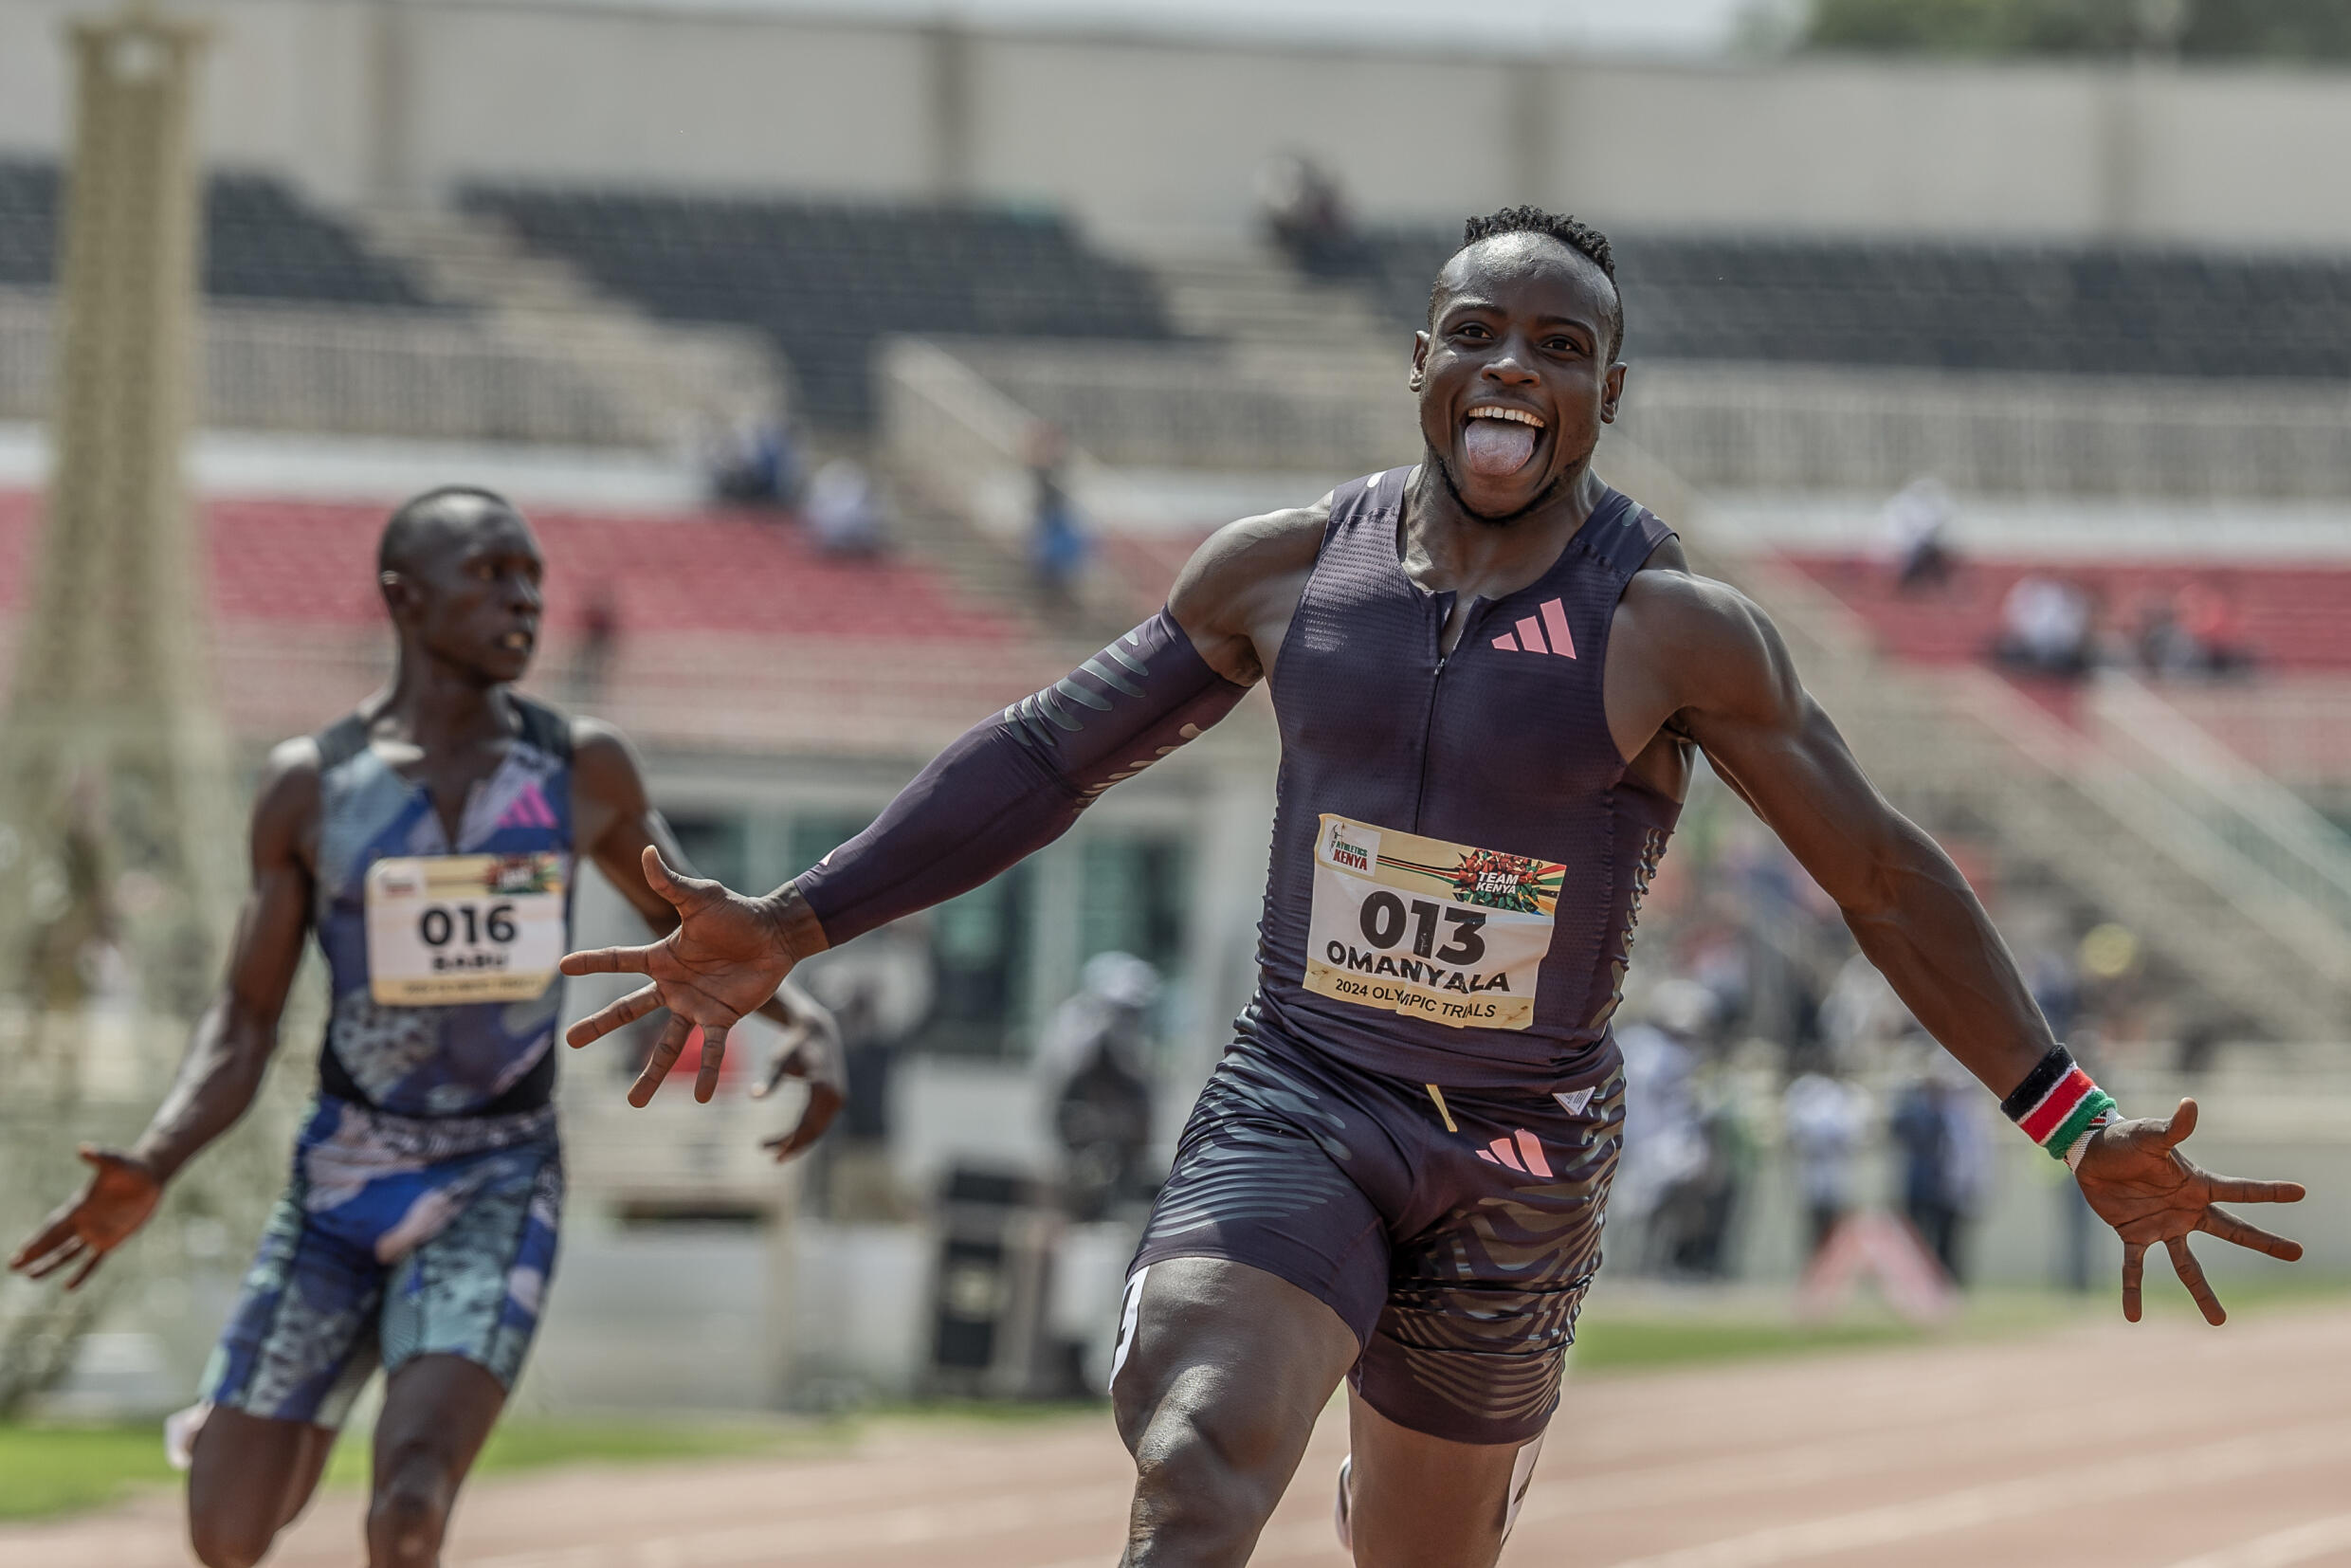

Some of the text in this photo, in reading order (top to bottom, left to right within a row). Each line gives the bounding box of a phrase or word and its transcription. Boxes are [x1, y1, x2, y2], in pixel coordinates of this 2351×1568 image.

[1333, 848, 1367, 871] KENYA
[1336, 841, 1367, 857] ATHLETICS
[1476, 882, 1516, 894] KENYA
[1479, 871, 1519, 884] TEAM
[420, 903, 517, 946] 016
[1359, 890, 1486, 966] 013
[1326, 939, 1511, 994] OMANYALA
[1336, 978, 1497, 1019] 2024 OLYMPIC TRIALS
